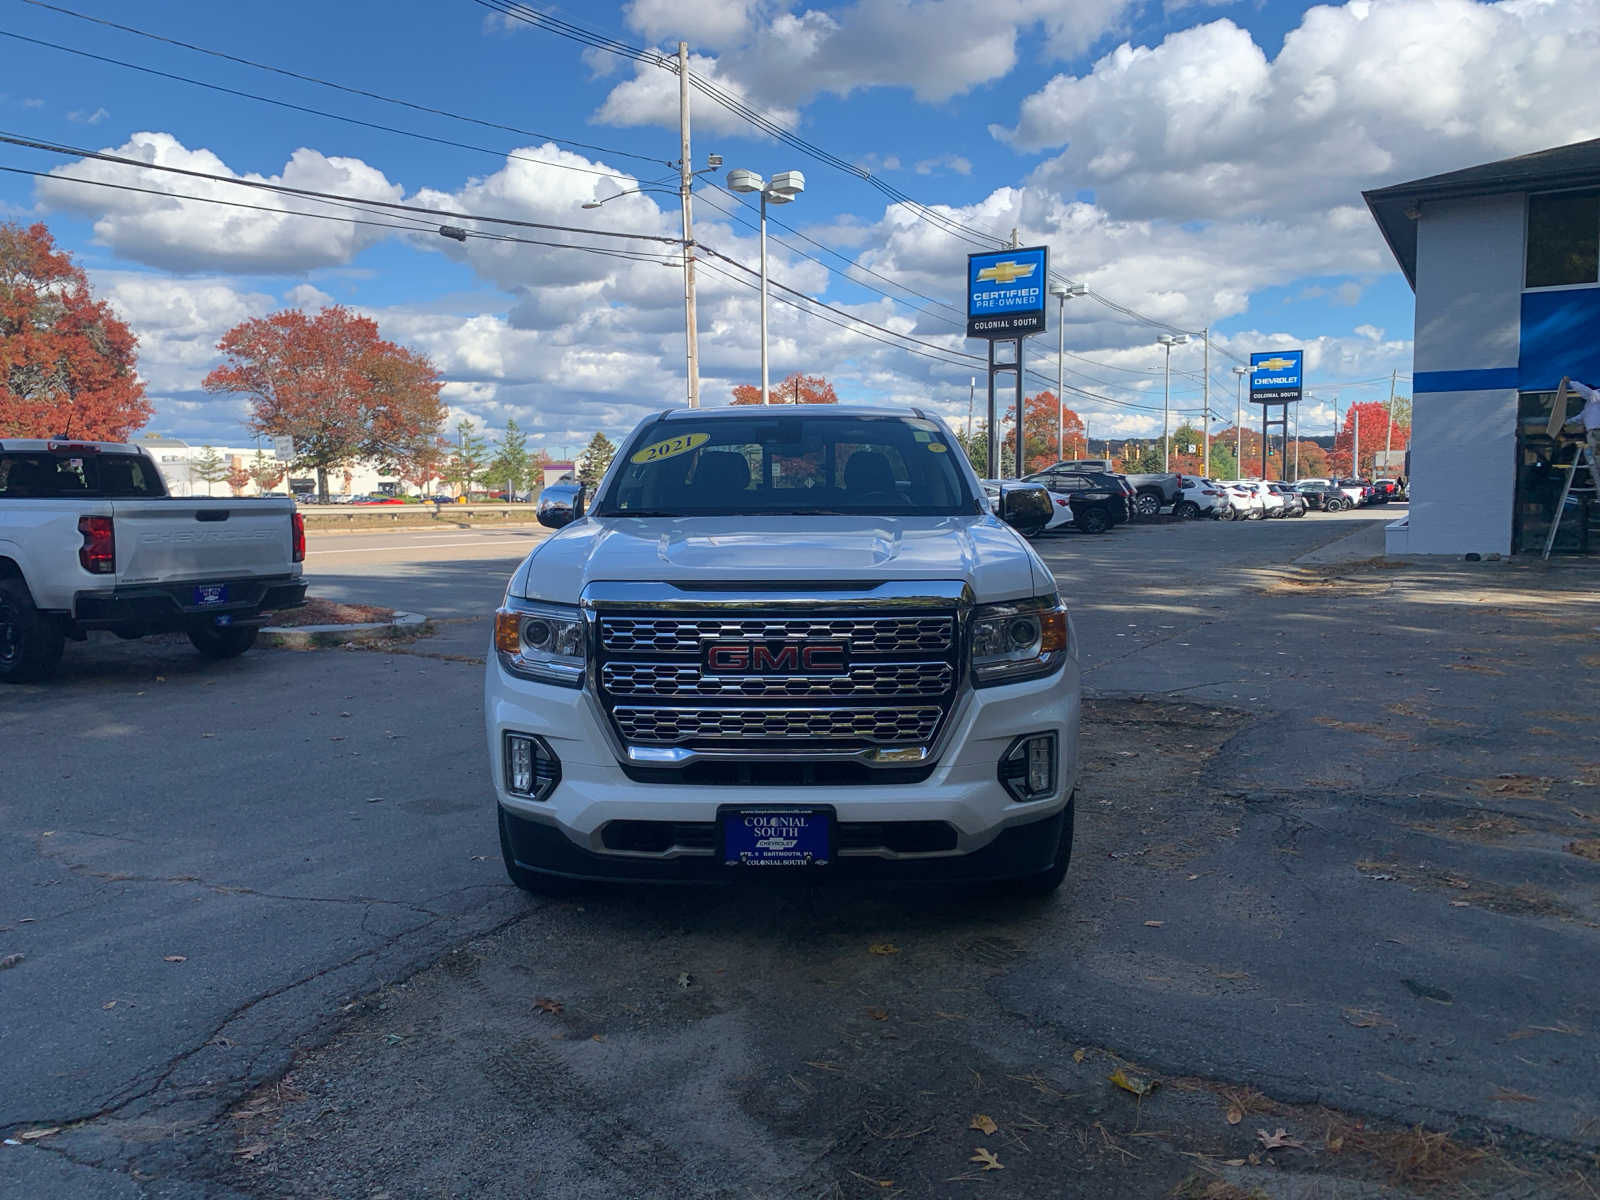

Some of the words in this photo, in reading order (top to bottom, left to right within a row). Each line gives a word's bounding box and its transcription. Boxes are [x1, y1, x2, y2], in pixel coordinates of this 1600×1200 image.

[973, 287, 1039, 301] CERTIFIED
[976, 296, 1036, 308] PRE-OWNED
[974, 320, 1009, 329] COLONIAL
[1013, 318, 1037, 327] SOUTH
[1254, 376, 1298, 385] CHEVROLET
[646, 436, 691, 460] 2021
[140, 528, 279, 544] CHEVROLET
[708, 646, 844, 670] GMC
[744, 817, 808, 827] COLONIAL
[754, 827, 798, 837] SOUTH
